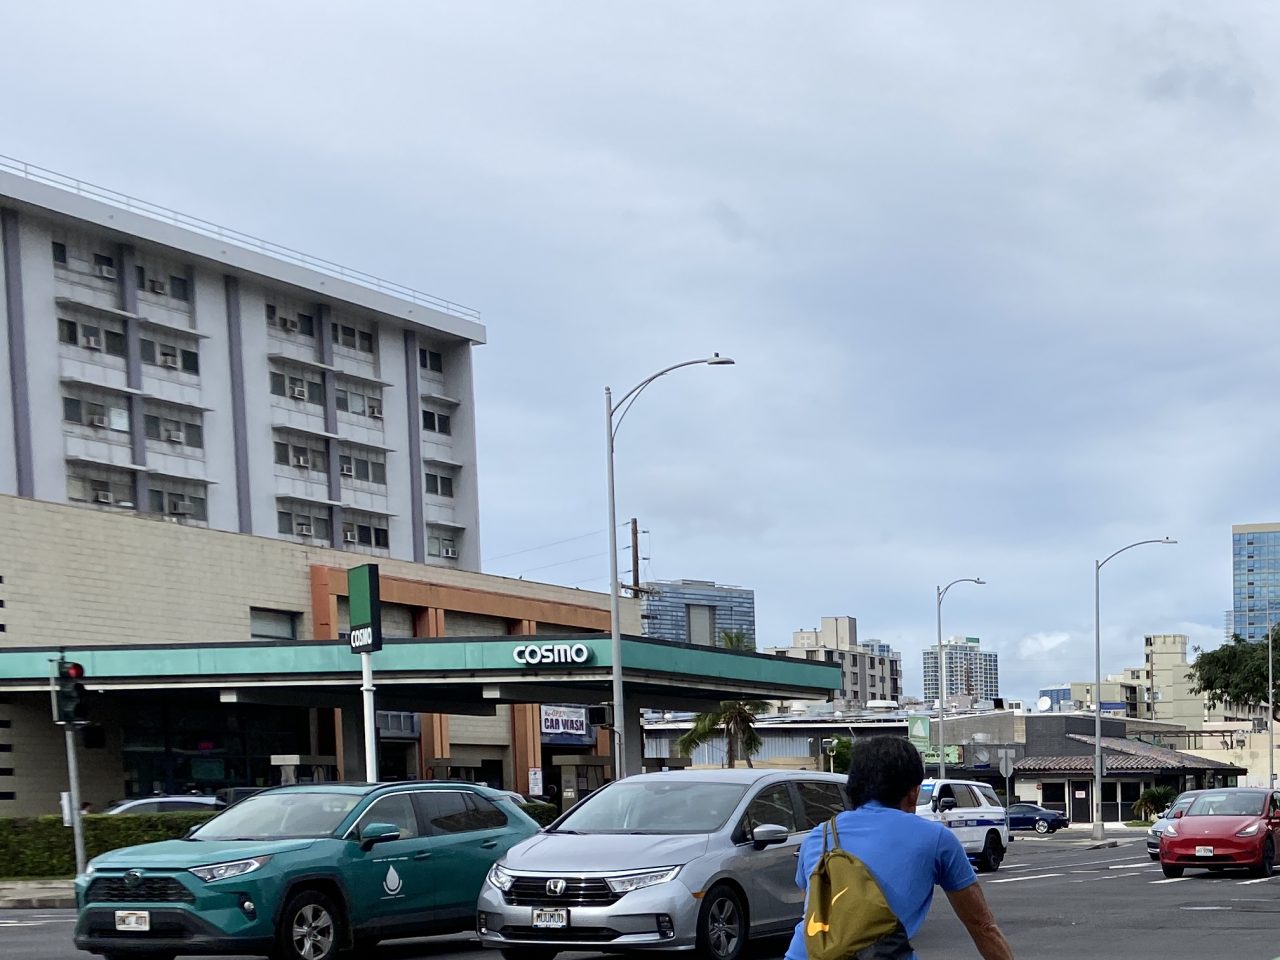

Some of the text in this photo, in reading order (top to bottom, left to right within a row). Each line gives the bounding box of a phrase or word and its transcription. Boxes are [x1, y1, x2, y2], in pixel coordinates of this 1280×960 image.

[351, 627, 372, 648] COSMO
[513, 643, 588, 664] COSMO
[544, 718, 584, 731] CAR WASH
